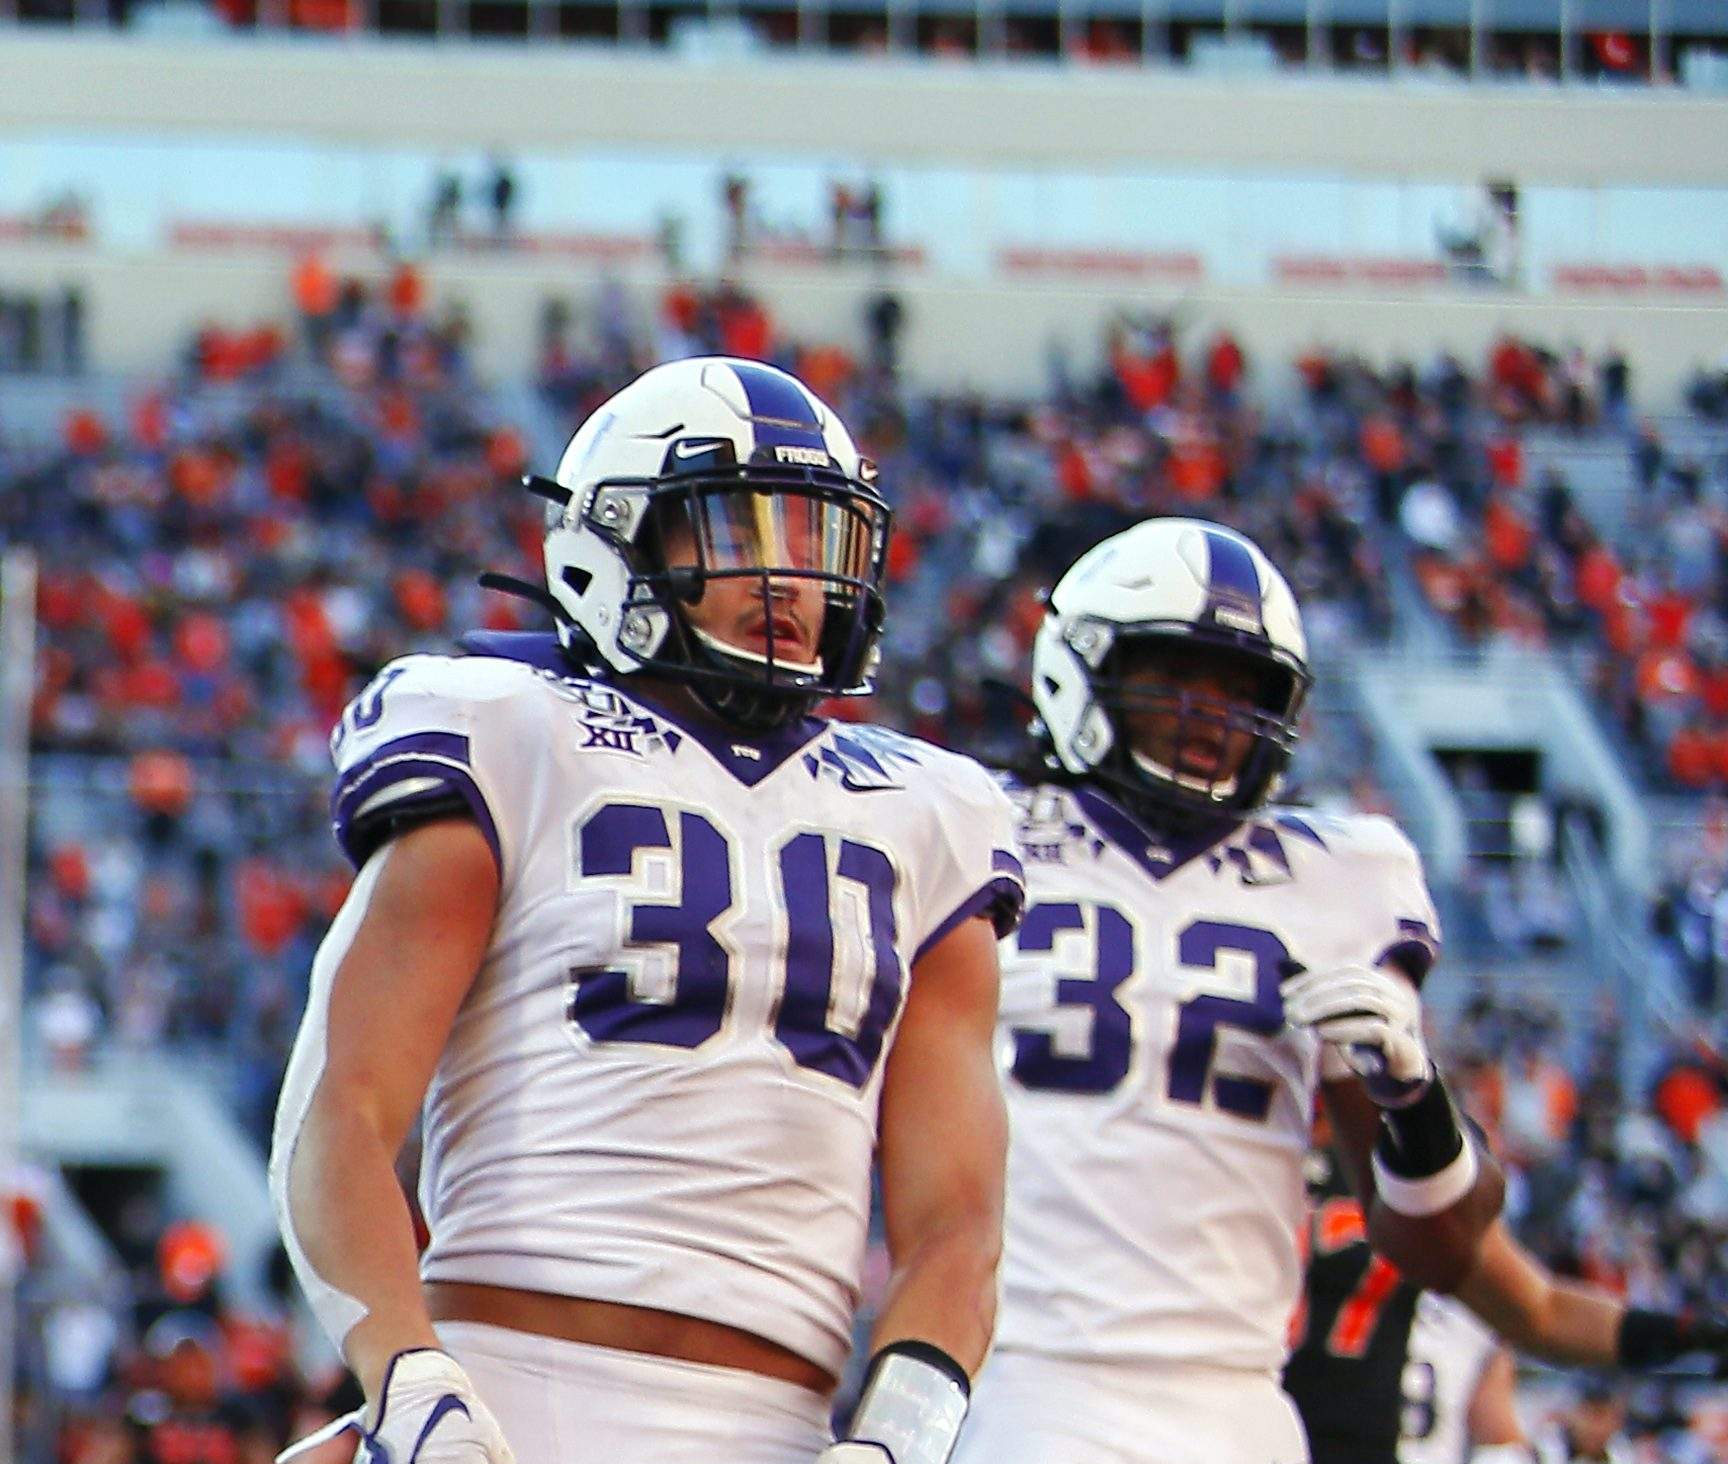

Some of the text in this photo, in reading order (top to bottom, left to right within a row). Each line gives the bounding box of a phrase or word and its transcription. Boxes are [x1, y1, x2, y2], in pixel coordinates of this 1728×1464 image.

[564, 795, 907, 1092] 30
[1006, 898, 1294, 1126] 32
[1287, 1196, 1402, 1359] 7
